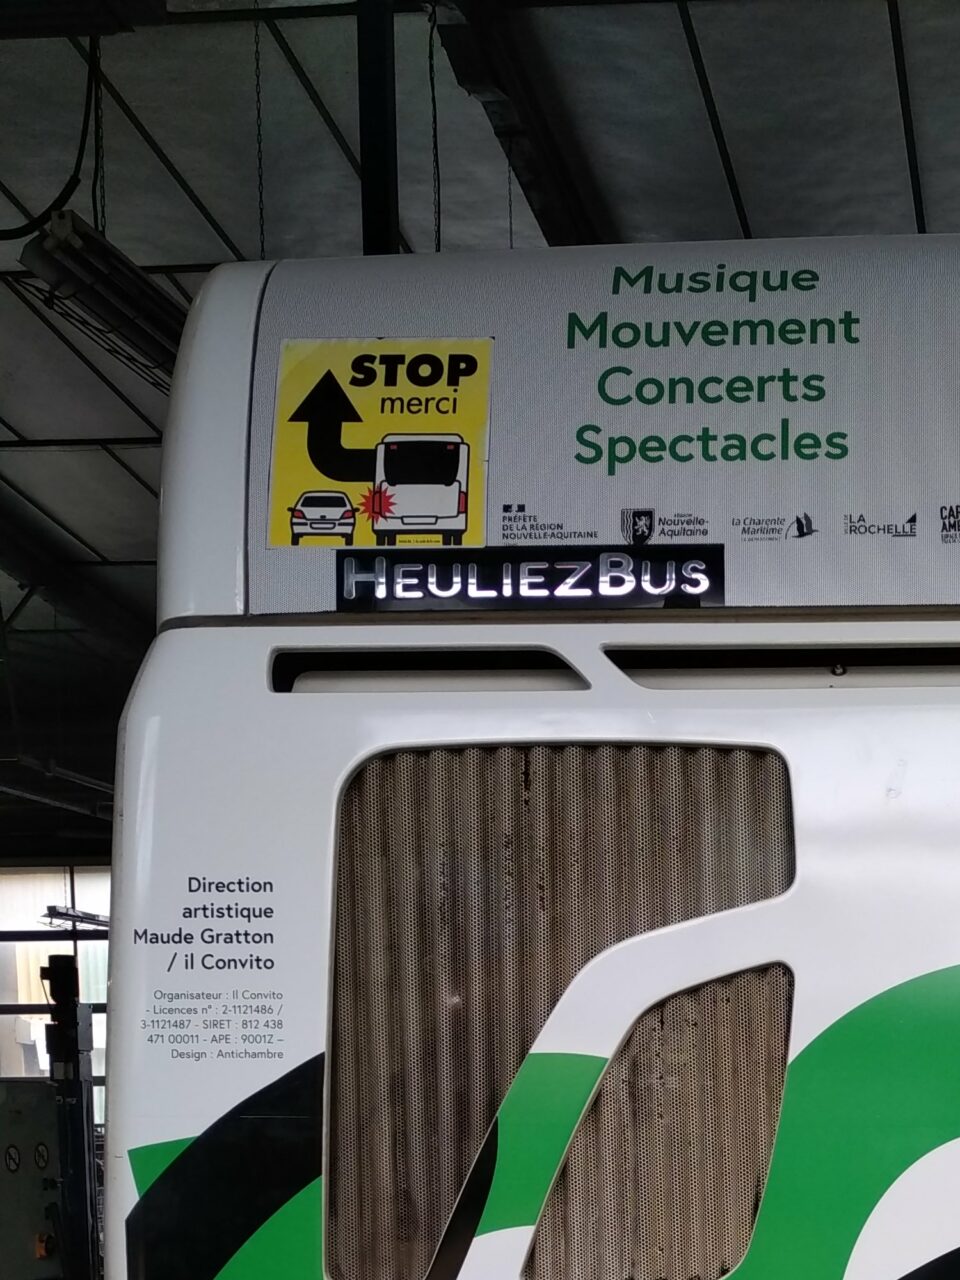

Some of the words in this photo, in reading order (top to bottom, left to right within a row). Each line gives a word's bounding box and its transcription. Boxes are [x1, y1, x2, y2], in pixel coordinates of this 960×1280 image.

[612, 264, 820, 301] Musique
[567, 310, 860, 349] Mouvement
[349, 353, 478, 387] STOP
[598, 366, 826, 405] Concerts
[381, 389, 459, 415] merci
[574, 418, 849, 475] Spectacles
[743, 516, 785, 526] Charente
[849, 514, 866, 524] LA
[502, 531, 598, 540] NOUVELLE-AQUITAINE
[658, 527, 708, 540] Aquitaine
[850, 524, 916, 535] ROCHELLE
[188, 876, 273, 893] Direction
[182, 903, 274, 923] artistique
[134, 927, 194, 944] Maude
[200, 928, 274, 944] Gratton
[167, 952, 177, 972] /
[184, 953, 194, 970] il
[201, 954, 274, 970] Convito
[154, 990, 222, 1002] Organisateur
[242, 990, 283, 1000] Convito
[153, 1004, 198, 1015] Licences
[222, 1005, 274, 1015] 2-1121486
[141, 1020, 191, 1029] 3-1121487
[202, 1020, 232, 1029] SIRET
[242, 1020, 260, 1029] 812
[263, 1020, 283, 1029] 438
[147, 1034, 164, 1044] 471
[168, 1034, 199, 1044] 00011
[210, 1034, 231, 1044] APE
[172, 1049, 206, 1061] Design
[217, 1048, 284, 1059] Antichambre
